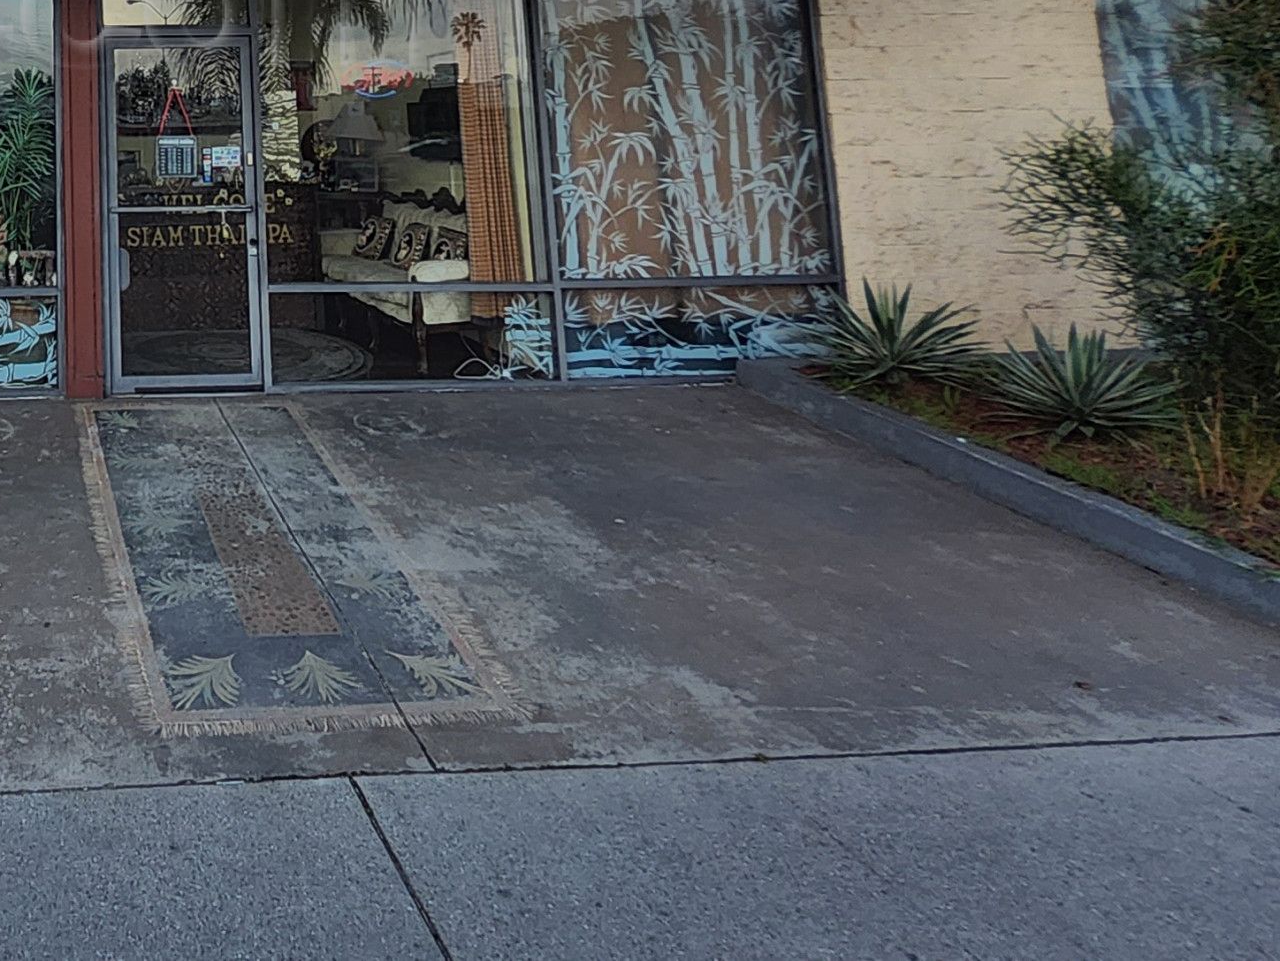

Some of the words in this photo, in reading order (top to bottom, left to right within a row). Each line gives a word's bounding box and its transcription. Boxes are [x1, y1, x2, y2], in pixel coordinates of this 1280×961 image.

[162, 193, 276, 213] WELCOE
[127, 224, 185, 247] SIAM
[264, 223, 294, 244] PA
